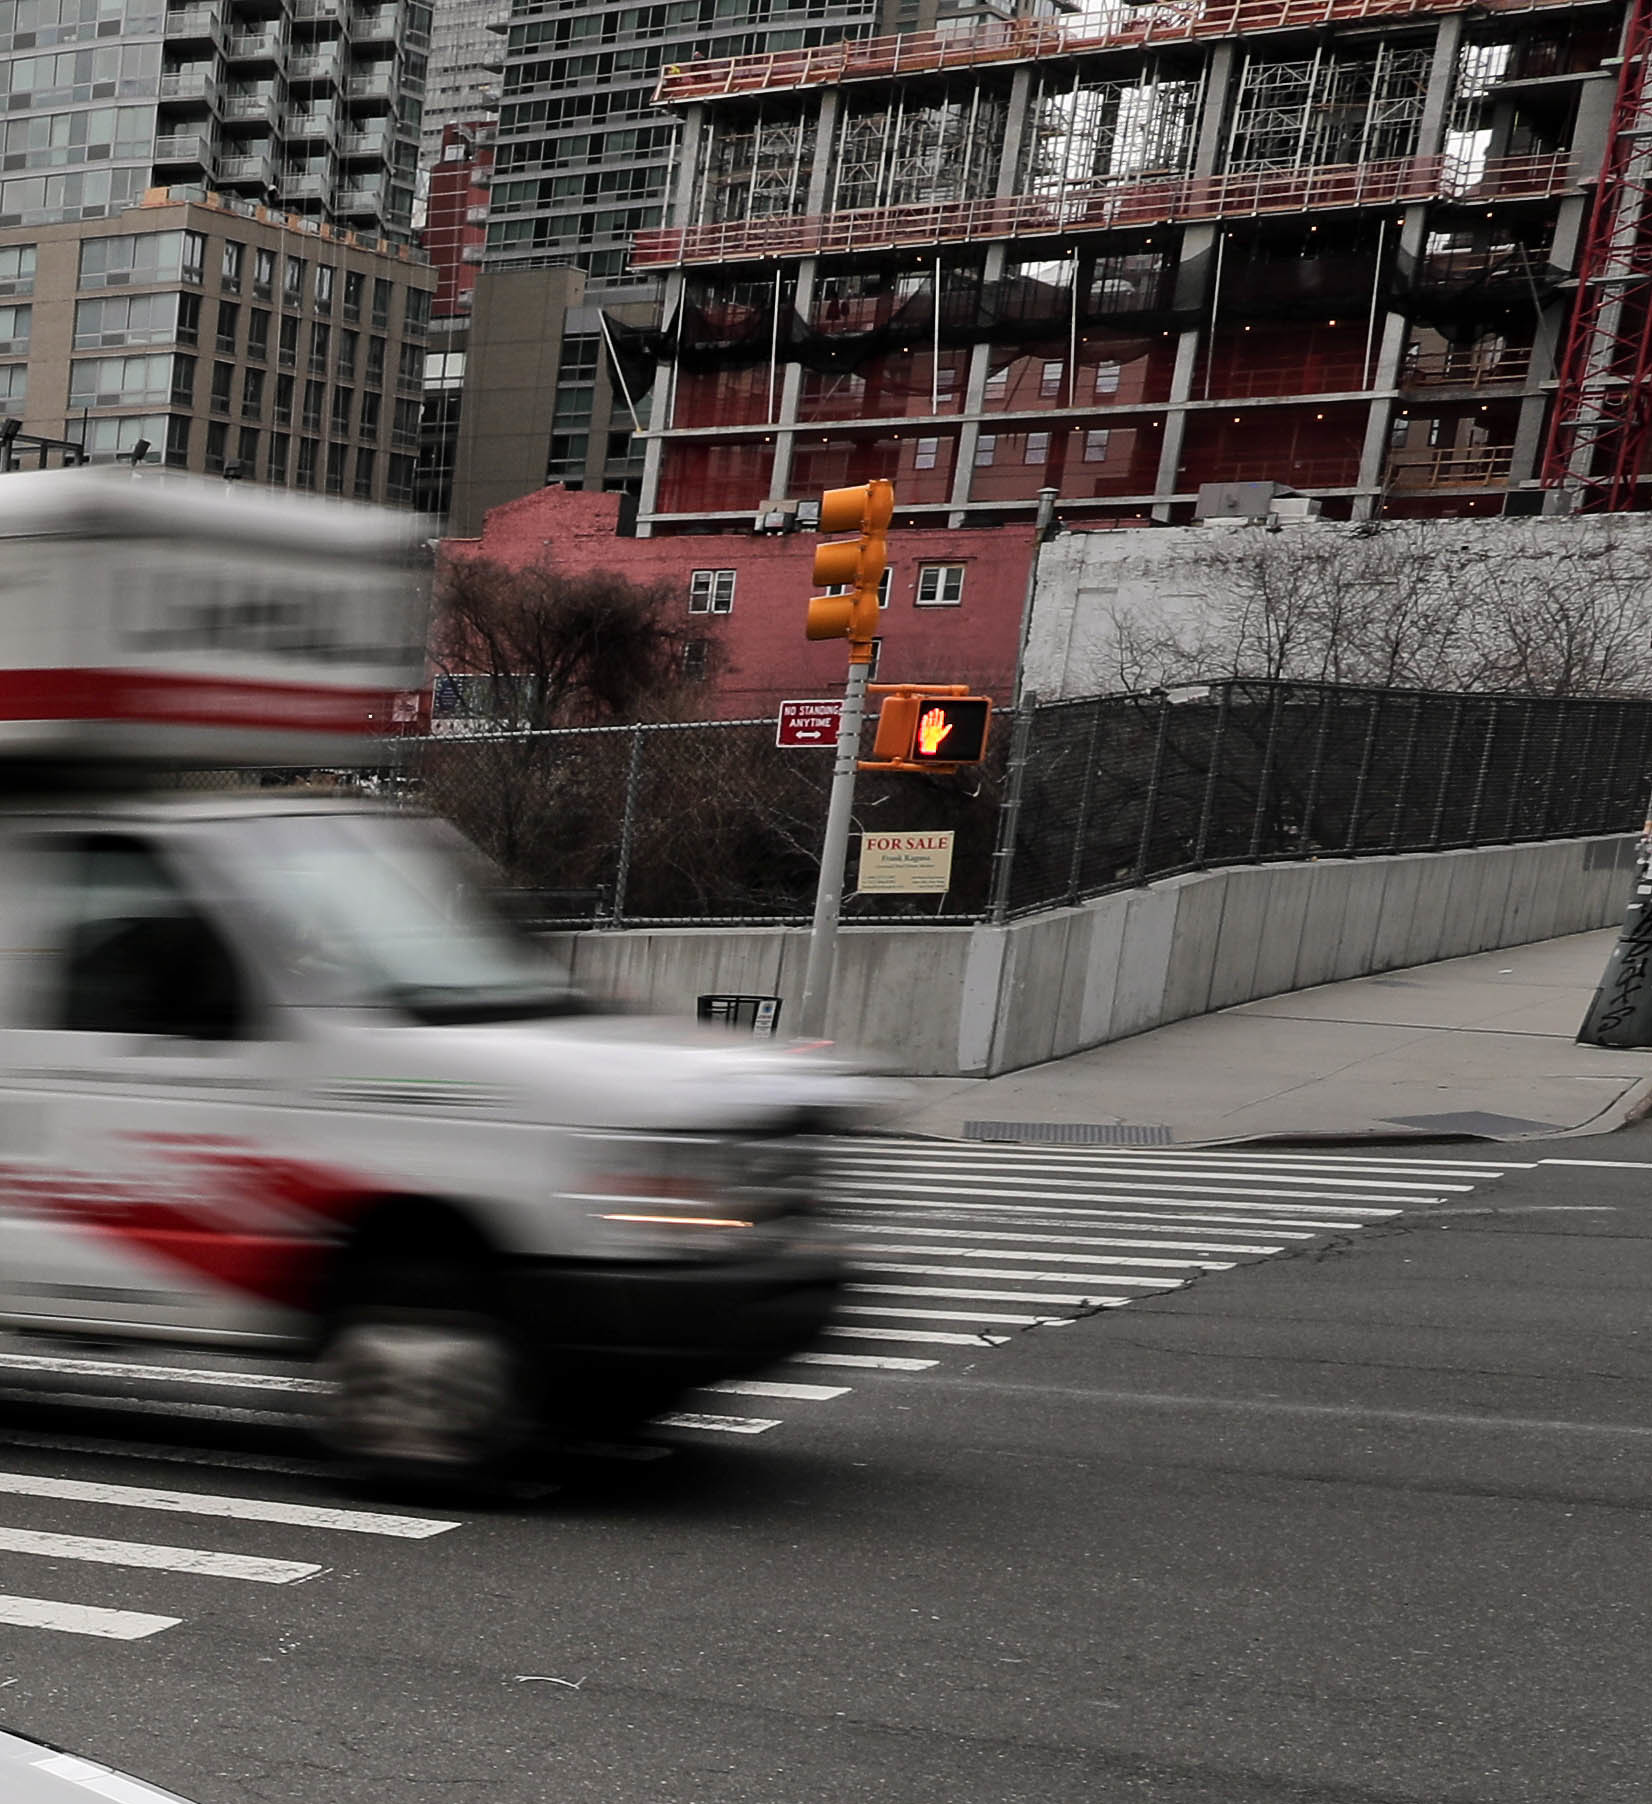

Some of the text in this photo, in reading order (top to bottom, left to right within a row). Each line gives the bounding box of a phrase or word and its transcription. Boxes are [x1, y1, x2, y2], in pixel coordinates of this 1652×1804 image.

[784, 705, 840, 716] NO STANDING
[789, 717, 832, 727] ANYTIME
[866, 836, 949, 851] FOR SALE
